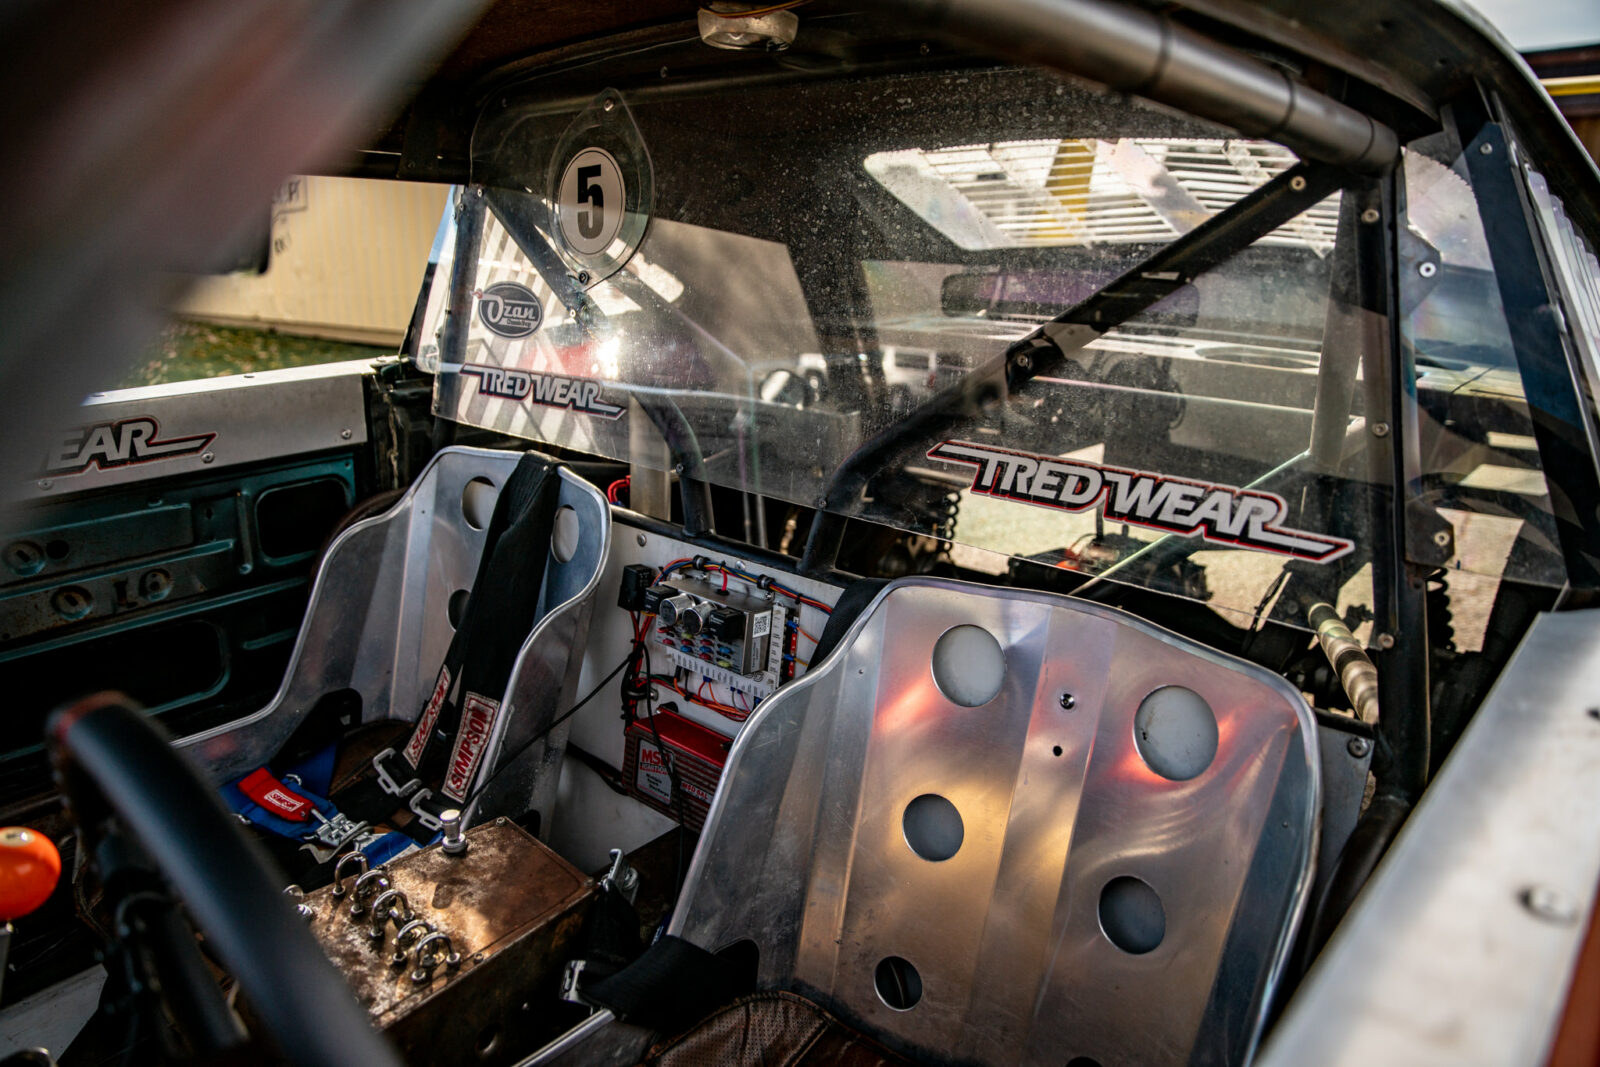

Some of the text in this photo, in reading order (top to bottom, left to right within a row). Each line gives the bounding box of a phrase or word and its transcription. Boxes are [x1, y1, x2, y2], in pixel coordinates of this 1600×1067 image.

[577, 164, 604, 239] 5
[484, 294, 536, 323] Ozan
[45, 418, 210, 473] EAR
[451, 703, 488, 790] SIMPSON
